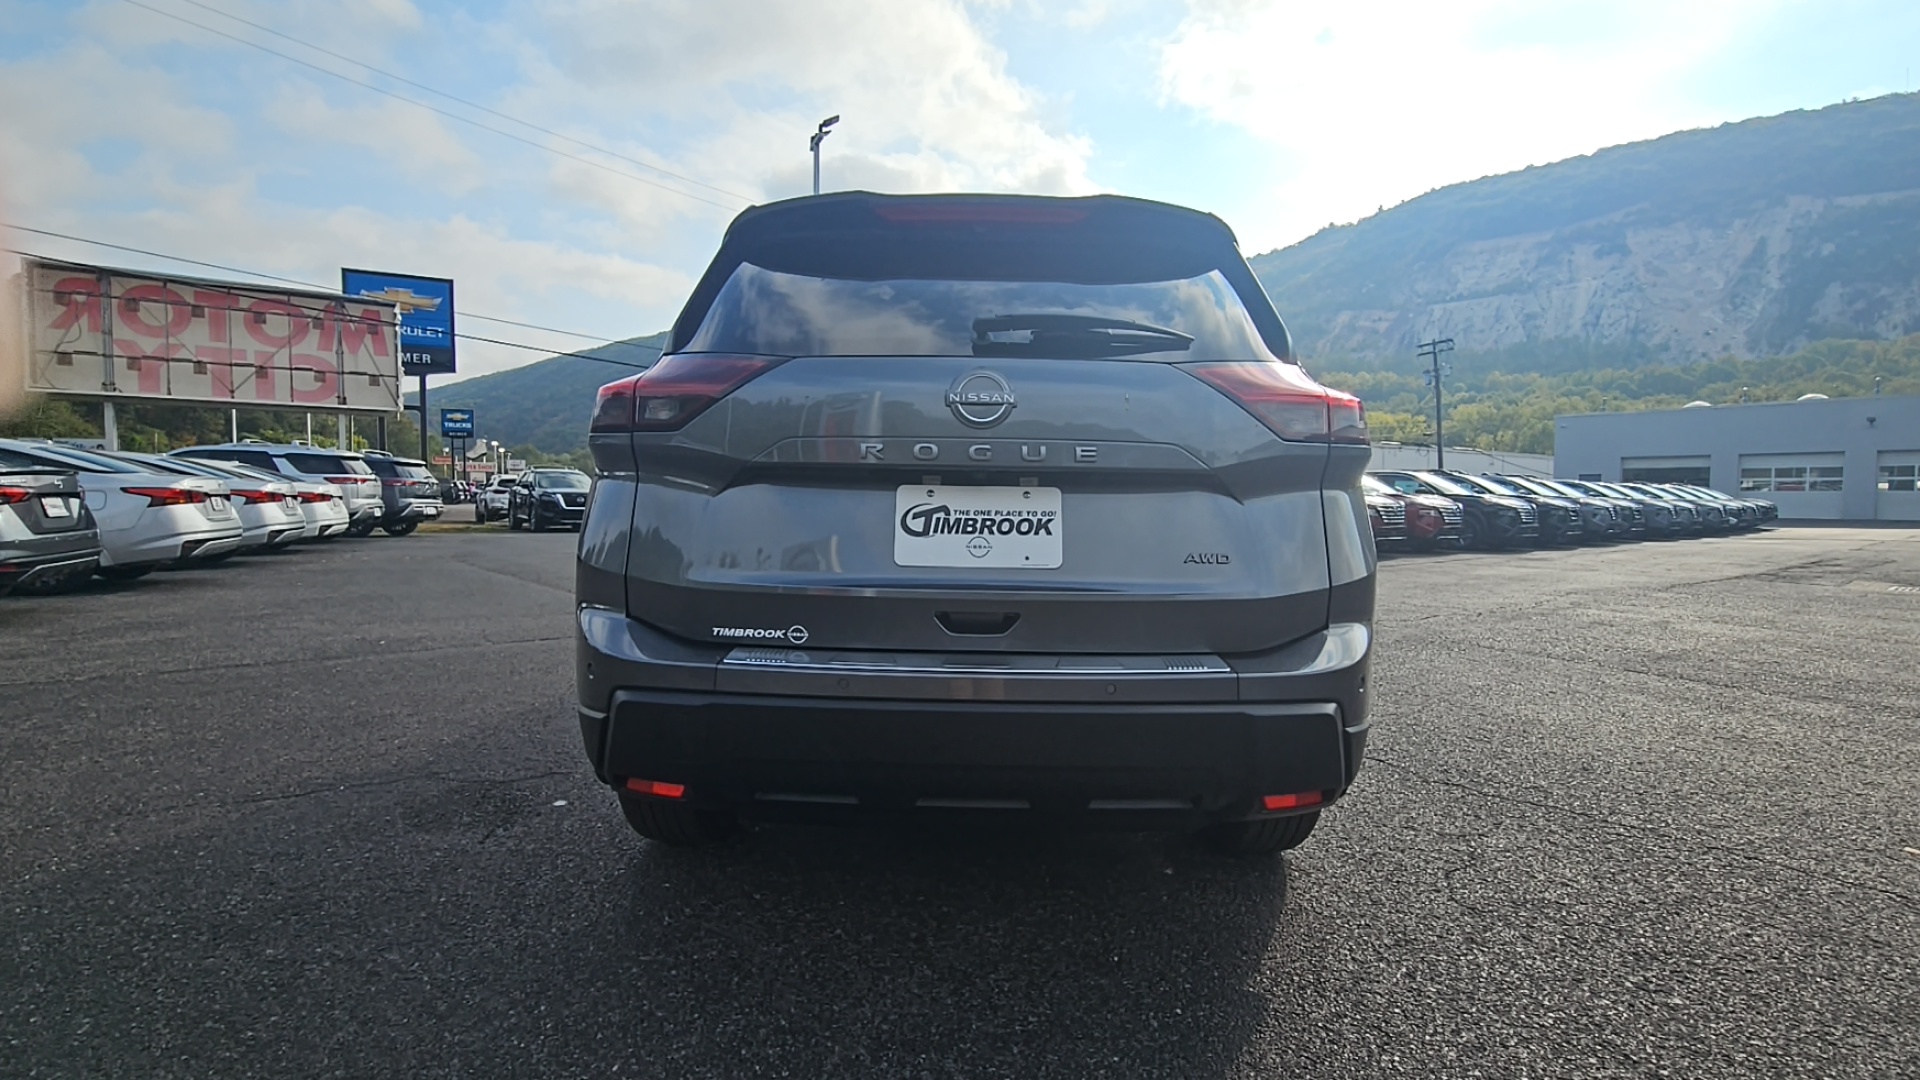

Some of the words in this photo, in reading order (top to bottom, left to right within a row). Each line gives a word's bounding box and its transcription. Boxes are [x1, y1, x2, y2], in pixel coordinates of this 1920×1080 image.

[400, 325, 445, 338] ROLET
[400, 352, 431, 364] MER
[949, 392, 1015, 403] NISSAN
[443, 421, 472, 429] TRUCKS
[859, 443, 1098, 463] ROGUE
[953, 509, 971, 517] THE
[973, 509, 993, 517] ONE
[994, 510, 1024, 518] PLACE
[901, 503, 1055, 538] TIMBROOK
[1183, 552, 1231, 565] AWD
[712, 627, 786, 639] TIMBROOK
